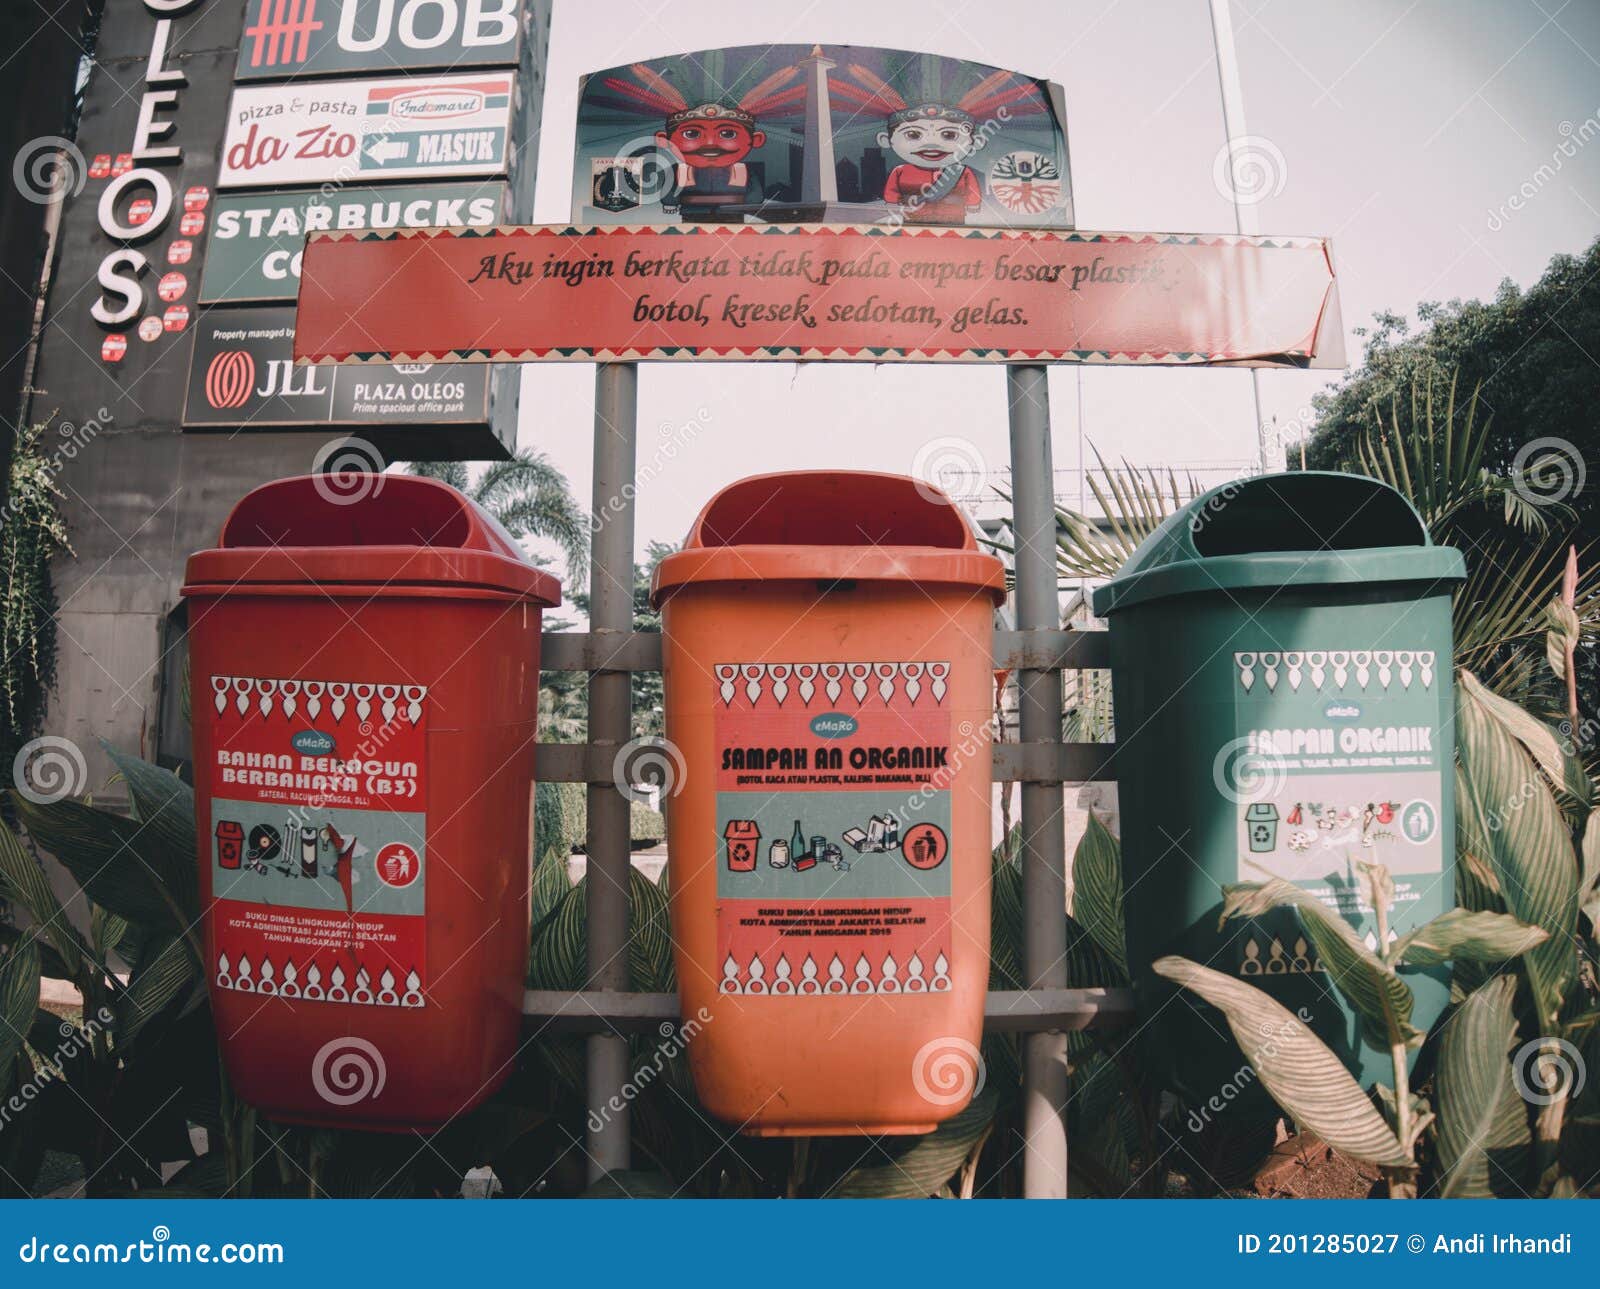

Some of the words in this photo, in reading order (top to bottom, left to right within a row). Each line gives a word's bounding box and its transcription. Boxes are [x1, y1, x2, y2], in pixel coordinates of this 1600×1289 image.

[337, 0, 518, 52] UOB
[239, 103, 284, 125] pizza
[309, 101, 357, 115] pasta
[397, 98, 477, 114] Indomaret
[228, 123, 289, 170] da
[294, 124, 356, 158] Zio
[416, 131, 496, 163] MASUK
[90, 0, 193, 324] LEOS
[215, 198, 496, 239] STARBUCKS
[468, 252, 534, 286] Aku
[543, 253, 614, 287] ingin
[623, 250, 730, 284] berkata
[739, 250, 822, 284] tidak
[819, 251, 891, 286] pada
[900, 256, 983, 288] empat
[994, 255, 1066, 283] besar
[633, 294, 710, 327] botol,
[722, 294, 817, 328] kresek,
[827, 295, 943, 327] sedotan,
[951, 297, 1029, 333] gelas.
[213, 329, 247, 341] Property
[248, 328, 285, 340] managed
[286, 328, 296, 339] by
[257, 360, 327, 397] JLL
[354, 383, 406, 400] PLAZA
[411, 382, 465, 400] OLEOS
[352, 402, 378, 414] Prime
[379, 402, 416, 415] spacious
[418, 401, 442, 413] office
[443, 401, 465, 414] park
[815, 720, 853, 732] eMaRo
[1248, 728, 1335, 755] SAMPAH
[1339, 726, 1432, 753] ORGANIK
[217, 750, 293, 771] BAHAN
[300, 756, 418, 779] BERACUN
[722, 747, 807, 770] SAMPAH
[815, 747, 843, 769] AN
[849, 746, 948, 769] ORGANIK
[222, 767, 358, 792] BERBAHAYA
[366, 776, 418, 798] (B3)
[787, 775, 807, 785] ATAU
[245, 911, 268, 922] SUKU
[270, 914, 296, 925] DINAS
[297, 917, 354, 929] LINGKUNGAN
[356, 921, 384, 931] HIDUP
[740, 918, 765, 927] KOTA
[768, 918, 836, 927] ADMINISTRASI
[838, 917, 880, 926] JAKARTA
[884, 917, 926, 926] SELATAN
[758, 908, 785, 917] SUKU
[787, 908, 816, 917] DINAS
[818, 908, 881, 917] LINGKUNGAN
[883, 907, 912, 916] HIDUP
[229, 919, 252, 929] KOTA
[253, 922, 312, 935] ADMINISTRASI
[356, 932, 397, 942] SELATAN
[263, 933, 292, 943] TAHUN
[294, 936, 341, 947] ANGGARAN
[779, 928, 811, 937] TAHUN
[814, 928, 867, 937] ANGGARAN
